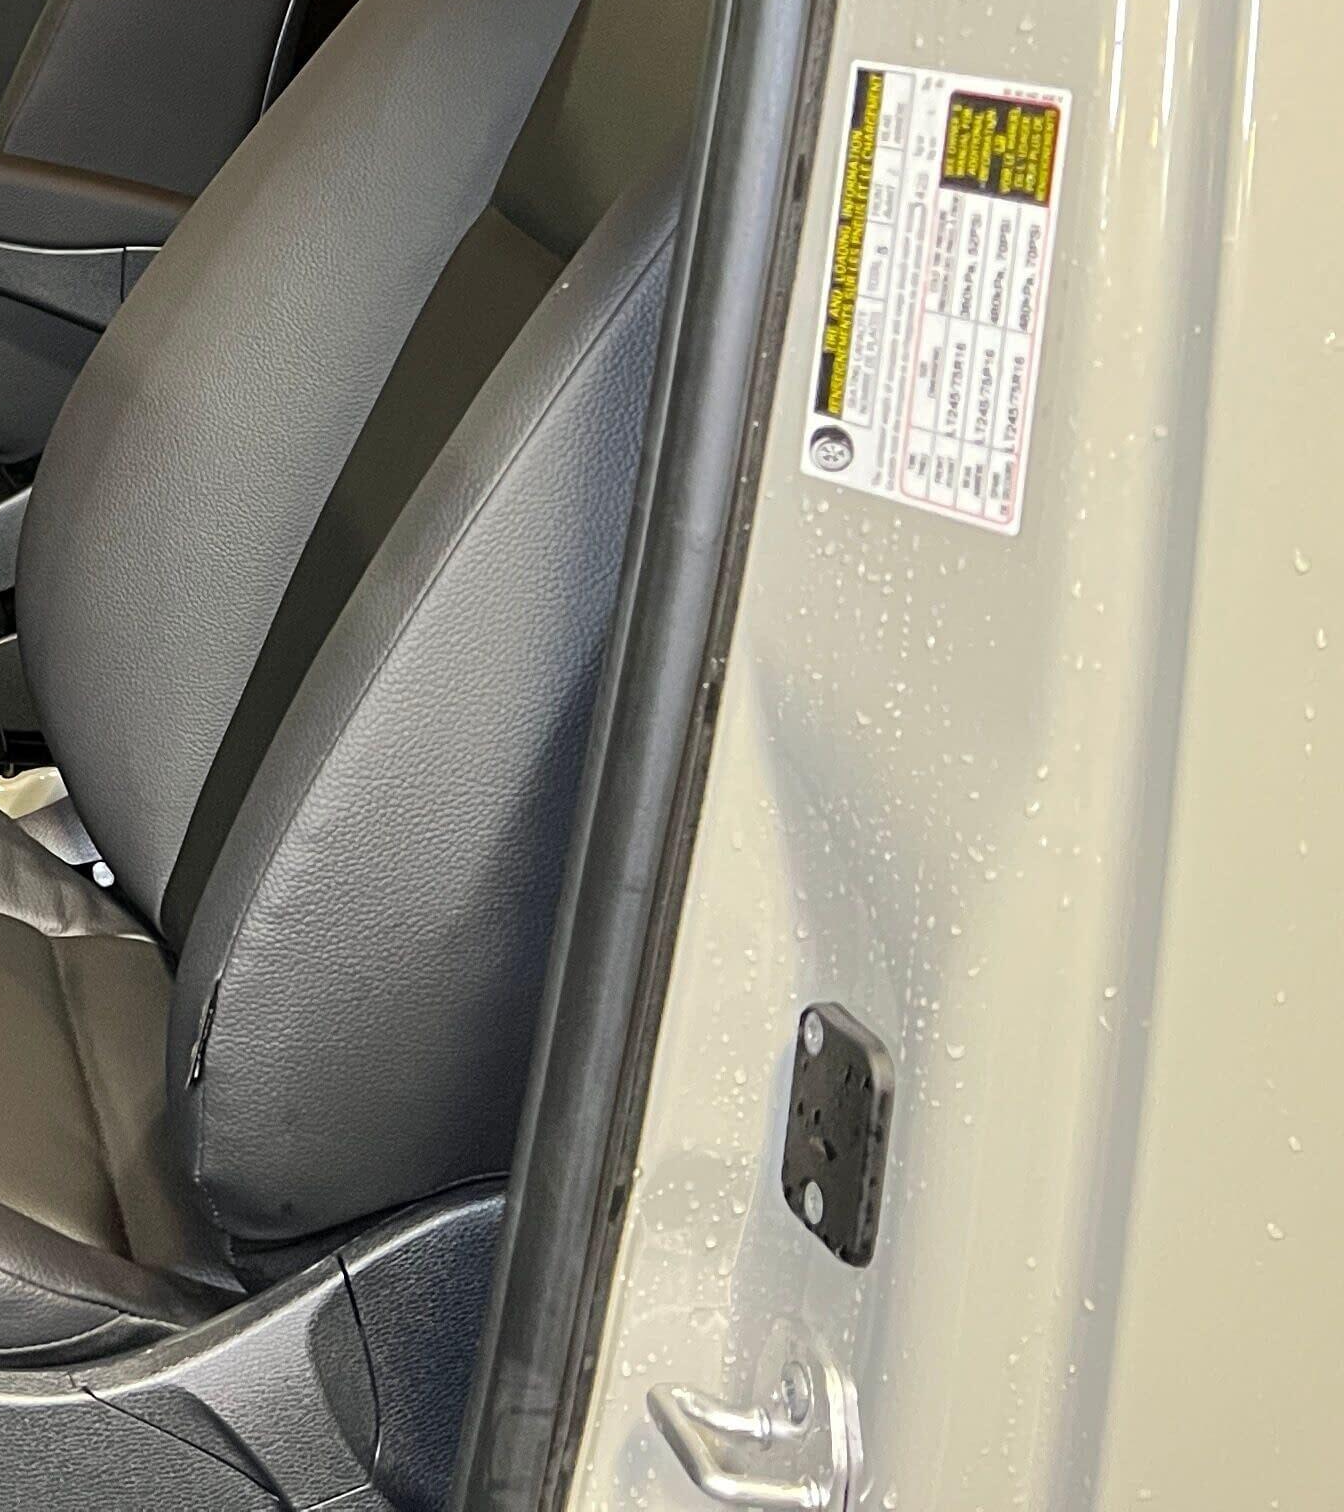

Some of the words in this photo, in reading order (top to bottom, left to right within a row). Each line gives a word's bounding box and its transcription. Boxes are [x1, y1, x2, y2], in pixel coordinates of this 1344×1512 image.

[860, 73, 883, 160] CHARGEMENT
[841, 128, 863, 218] INFORMATION
[827, 287, 843, 319] AND
[823, 324, 838, 353] TIRE
